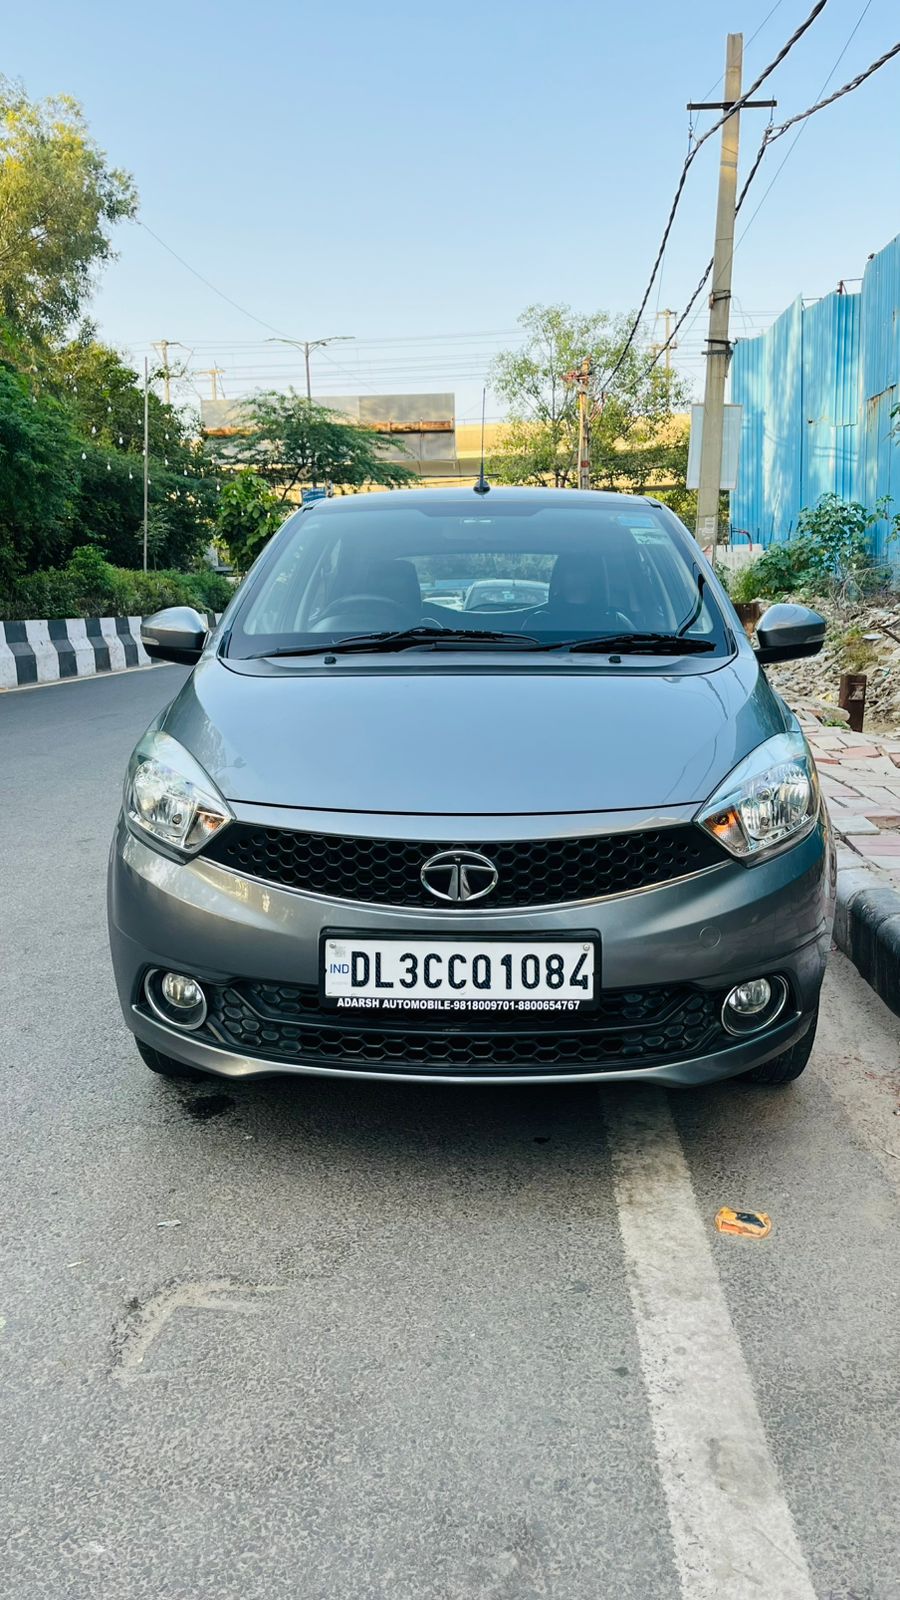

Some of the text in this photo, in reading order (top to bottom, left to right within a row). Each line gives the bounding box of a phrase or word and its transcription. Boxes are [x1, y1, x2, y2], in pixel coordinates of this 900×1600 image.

[329, 963, 349, 974] IND
[351, 951, 588, 990] DL3CCQ1084
[337, 998, 380, 1008] ADARSH
